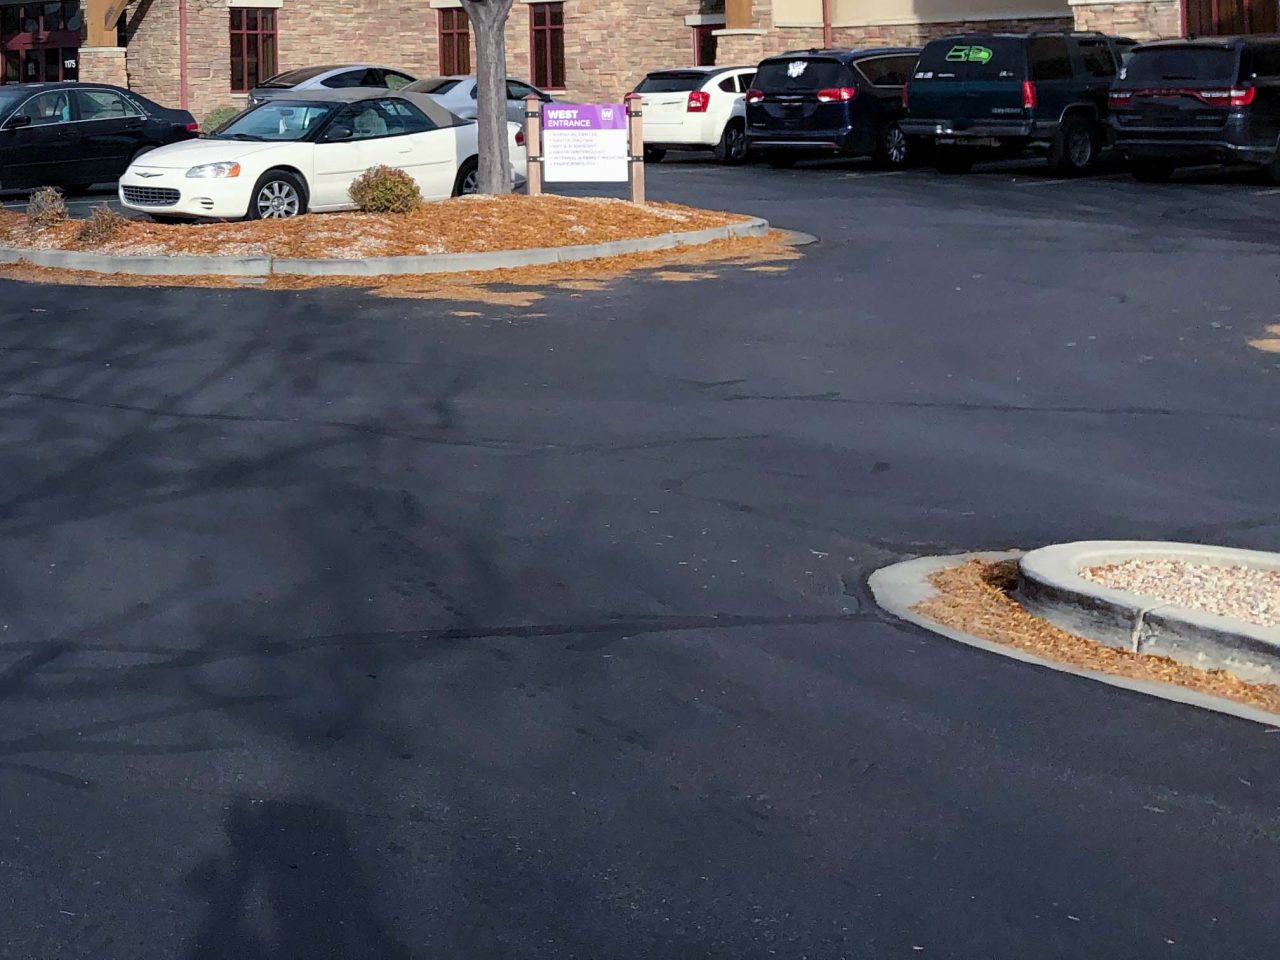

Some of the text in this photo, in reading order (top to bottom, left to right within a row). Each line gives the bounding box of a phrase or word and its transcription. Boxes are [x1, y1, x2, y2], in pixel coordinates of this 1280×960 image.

[64, 59, 76, 68] 1175
[548, 109, 578, 119] WEST
[548, 119, 591, 127] ENTRANCE
